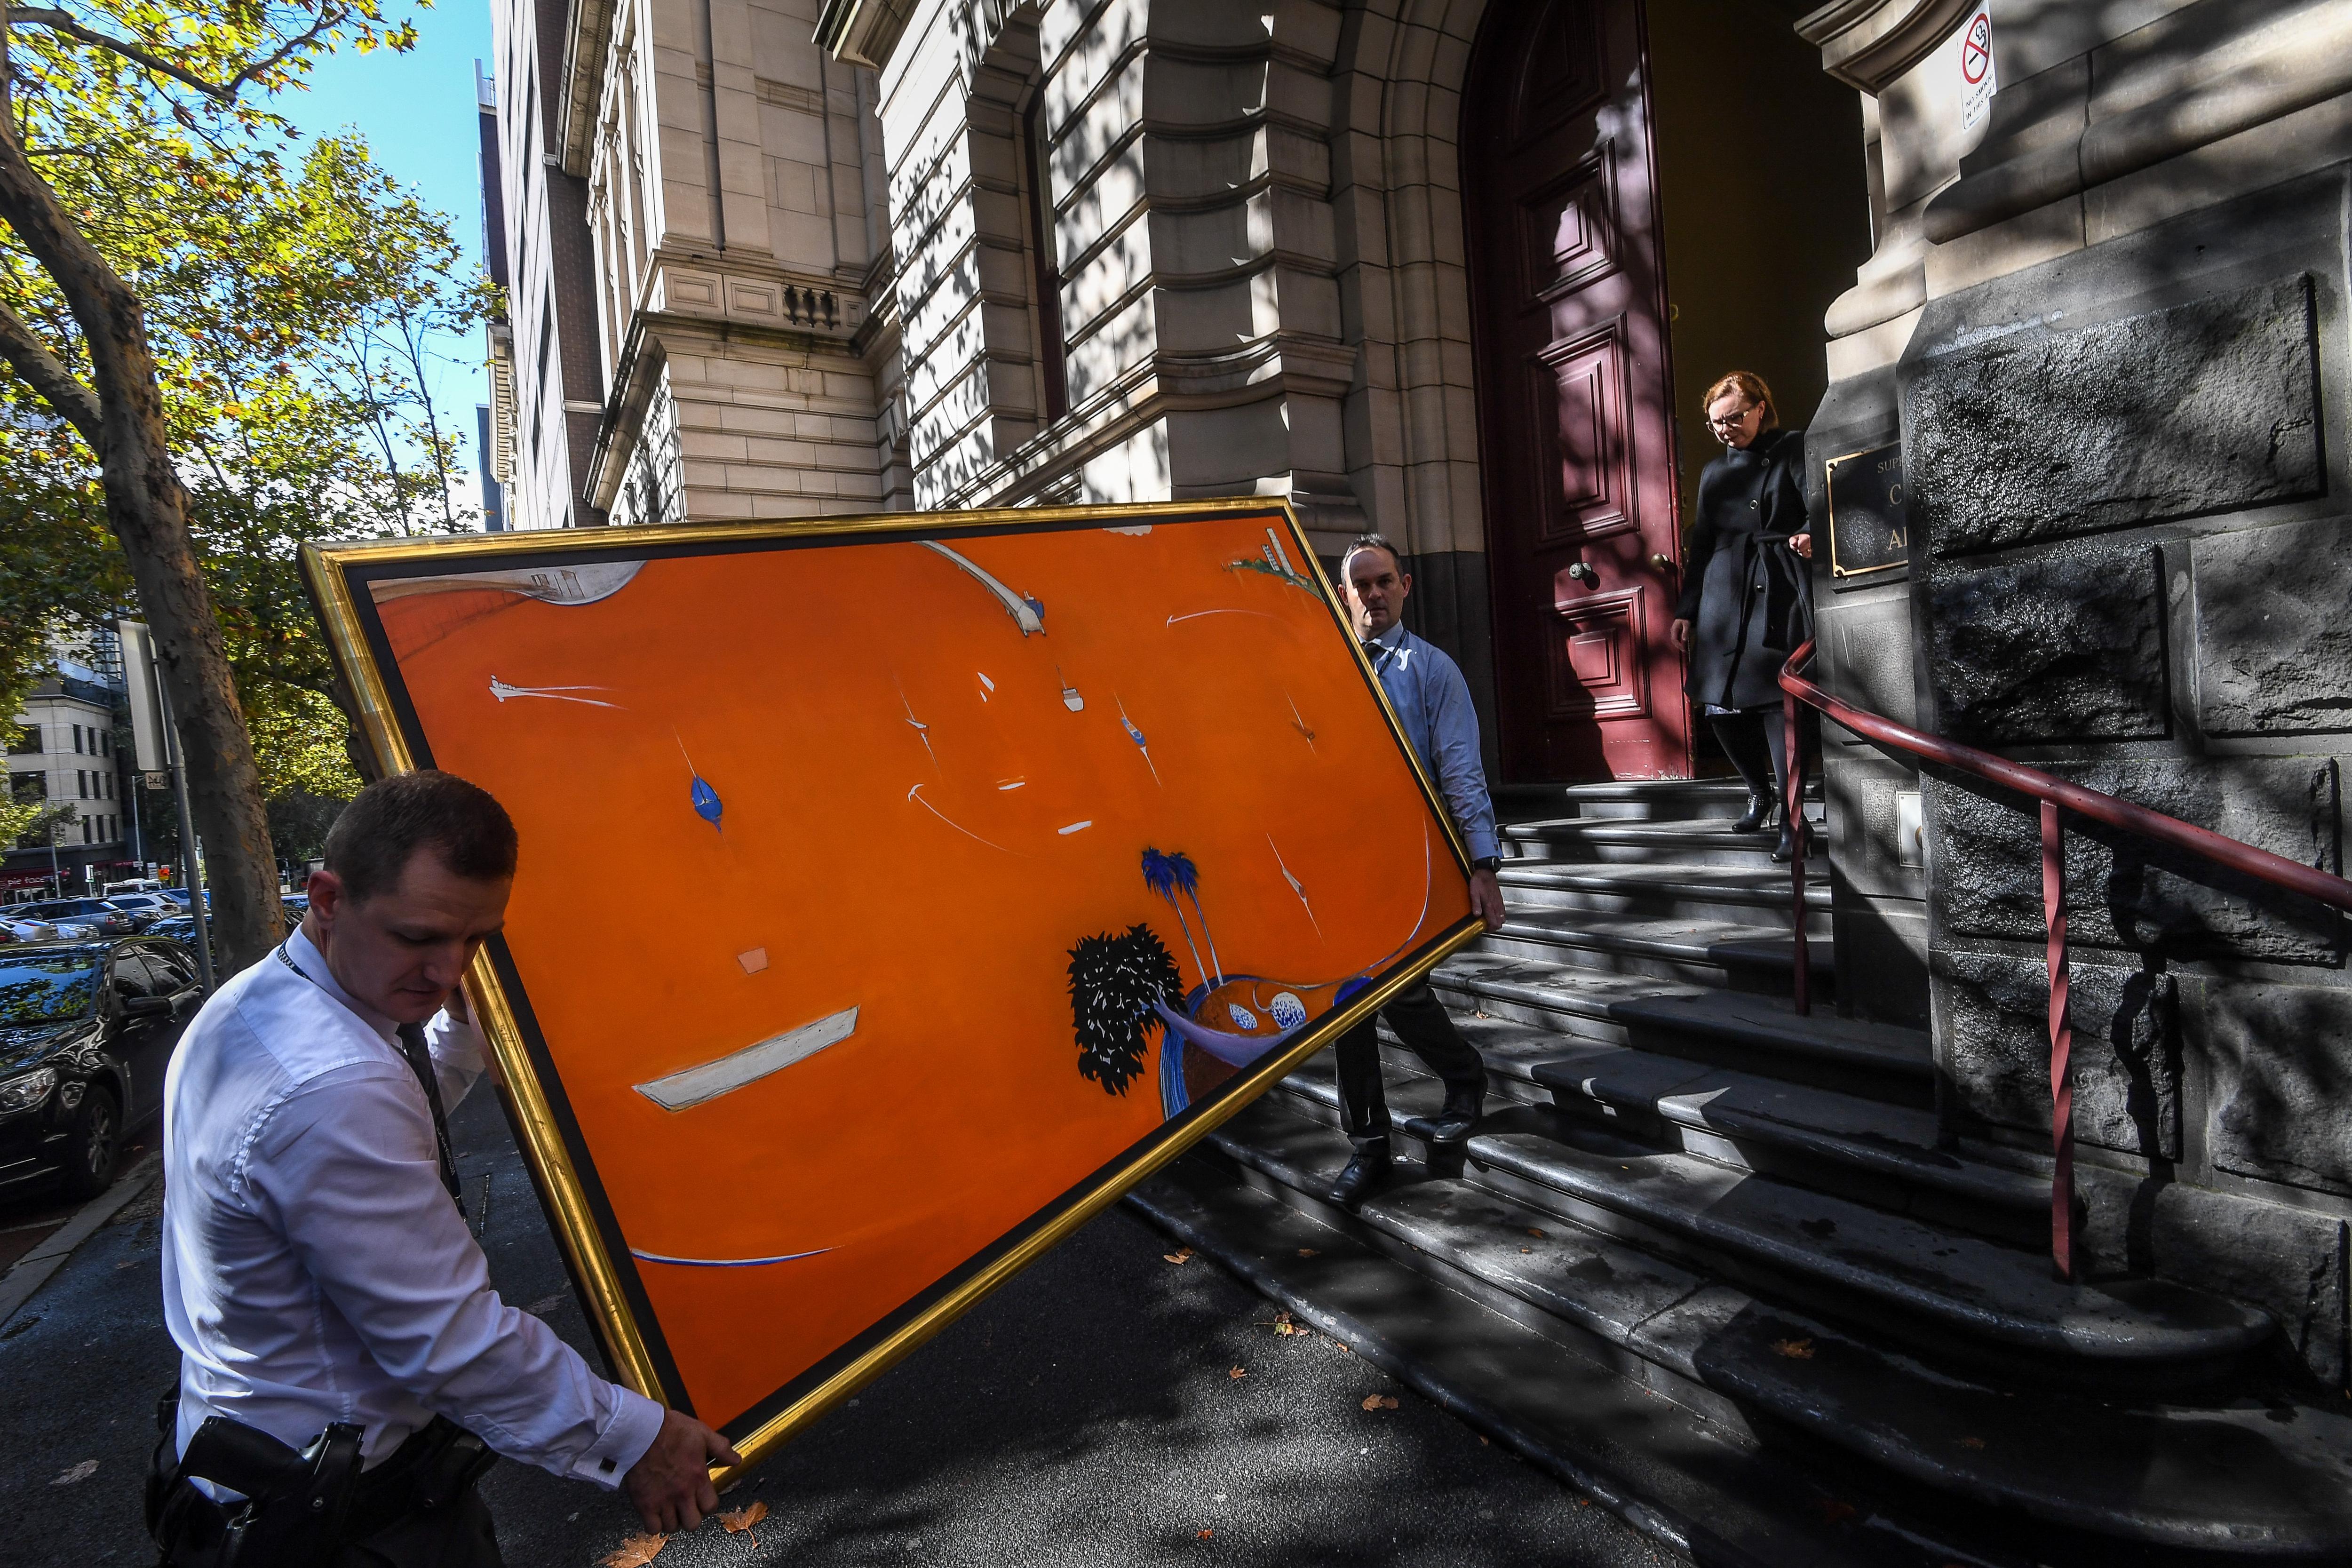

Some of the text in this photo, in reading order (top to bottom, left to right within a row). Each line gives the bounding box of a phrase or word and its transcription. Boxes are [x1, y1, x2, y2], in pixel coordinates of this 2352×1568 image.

[1966, 70, 1994, 108] NO SMOKING
[1966, 111, 1971, 120] IN
[1974, 98, 1984, 113] THIS
[1985, 83, 1994, 101] AREA
[8, 877, 22, 886] pie
[445, 1146, 456, 1176] VICTORIA
